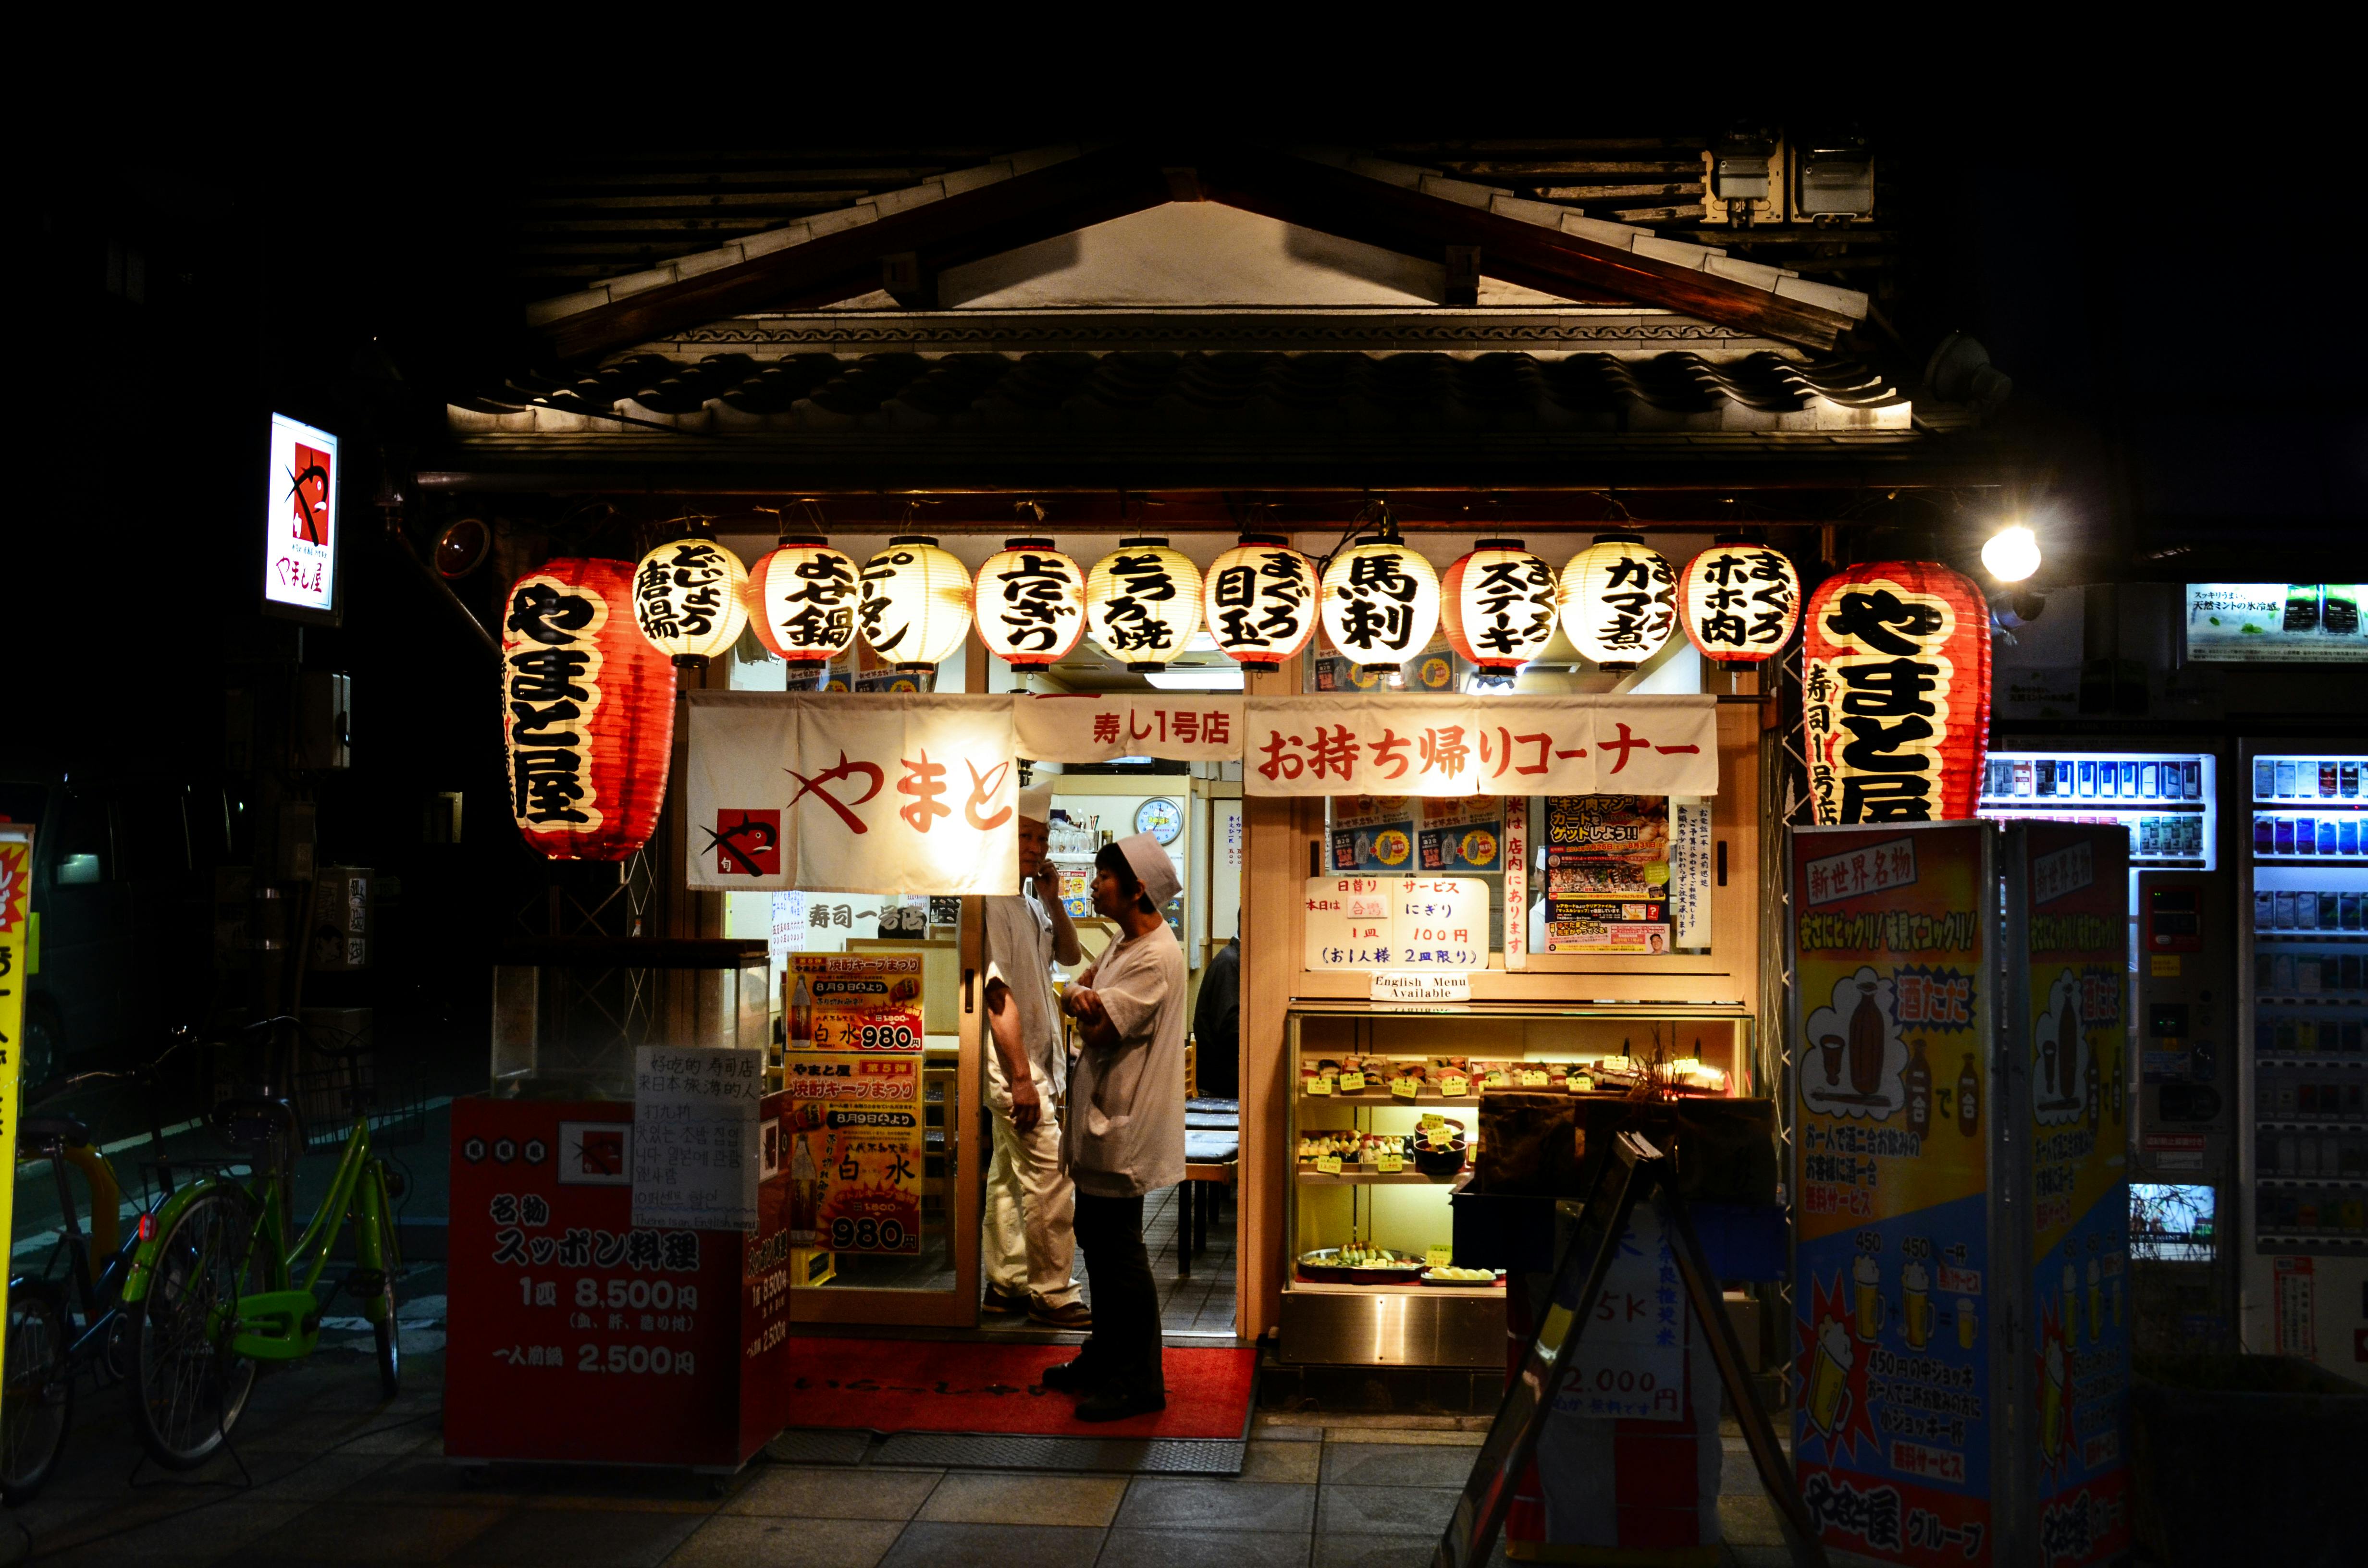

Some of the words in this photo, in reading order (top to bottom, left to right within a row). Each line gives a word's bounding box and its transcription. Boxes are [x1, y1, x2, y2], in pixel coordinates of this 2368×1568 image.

[276, 556, 321, 592] やまと屋
[672, 545, 725, 636] どじょう
[636, 560, 680, 639] 唐揚
[781, 553, 856, 649] よせ鍋
[997, 554, 1075, 650] 上にぎり
[1215, 565, 1270, 648] 目玉
[1258, 551, 1310, 638] まぐろ
[1337, 553, 1418, 650] 馬刺
[1476, 562, 1528, 654] ステーキ
[1597, 557, 1651, 652] カマ煮
[1702, 554, 1749, 647] ホホ肉
[1744, 552, 1794, 644] まぐろ
[507, 583, 594, 823] やまと屋
[1094, 709, 1229, 744] 寿し1号店
[1258, 723, 1701, 782] お持ち帰りコーナー
[782, 748, 1013, 834] やまと
[1551, 826, 1638, 841] ゲットしよう!!
[1552, 813, 1602, 825] カードを
[1338, 880, 1377, 894] 日替り
[1403, 881, 1459, 894] サービス
[1507, 797, 1525, 954] 米は店内にあります
[1810, 846, 1911, 900] 新世界名物
[808, 904, 927, 931] 寿司一号店
[1306, 898, 1341, 911] 本日は
[1406, 903, 1452, 918] にぎり
[1353, 927, 1379, 938] 1皿
[1414, 928, 1468, 942] 100円
[828, 958, 918, 972] 焼酎キープまつり
[1322, 947, 1391, 963] (お1人様
[1405, 949, 1477, 963] 2皿限り)
[1375, 976, 1422, 987] English
[1433, 977, 1466, 986] Menu
[1390, 989, 1451, 998] Available
[1898, 973, 1970, 1023] 酒ただ
[860, 1025, 921, 1049] 980円
[794, 1063, 851, 1078] やまと屋
[866, 1063, 907, 1074] 第5弾
[793, 1078, 914, 1099] 焼酎キープまつり
[636, 1125, 676, 1144] 맛있는
[491, 1194, 549, 1226] 名物
[1805, 1184, 1873, 1215] 無料サービス
[635, 1213, 666, 1226] There
[694, 1215, 731, 1229] English
[733, 1219, 756, 1228] menu
[831, 1216, 917, 1250] 980円
[493, 1228, 700, 1271] スッポン料理
[1855, 1231, 1881, 1252] 450
[1902, 1236, 1929, 1259] 450
[519, 1276, 557, 1308] 1匹
[574, 1277, 699, 1311] 8,500円
[491, 1345, 564, 1366] 一人前鍋
[577, 1345, 696, 1374] 2,500円
[1869, 1350, 1974, 1390] 450円の中ジョッキ
[1893, 1444, 1963, 1480] 無料サービス
[1908, 1508, 1984, 1557] グループ
